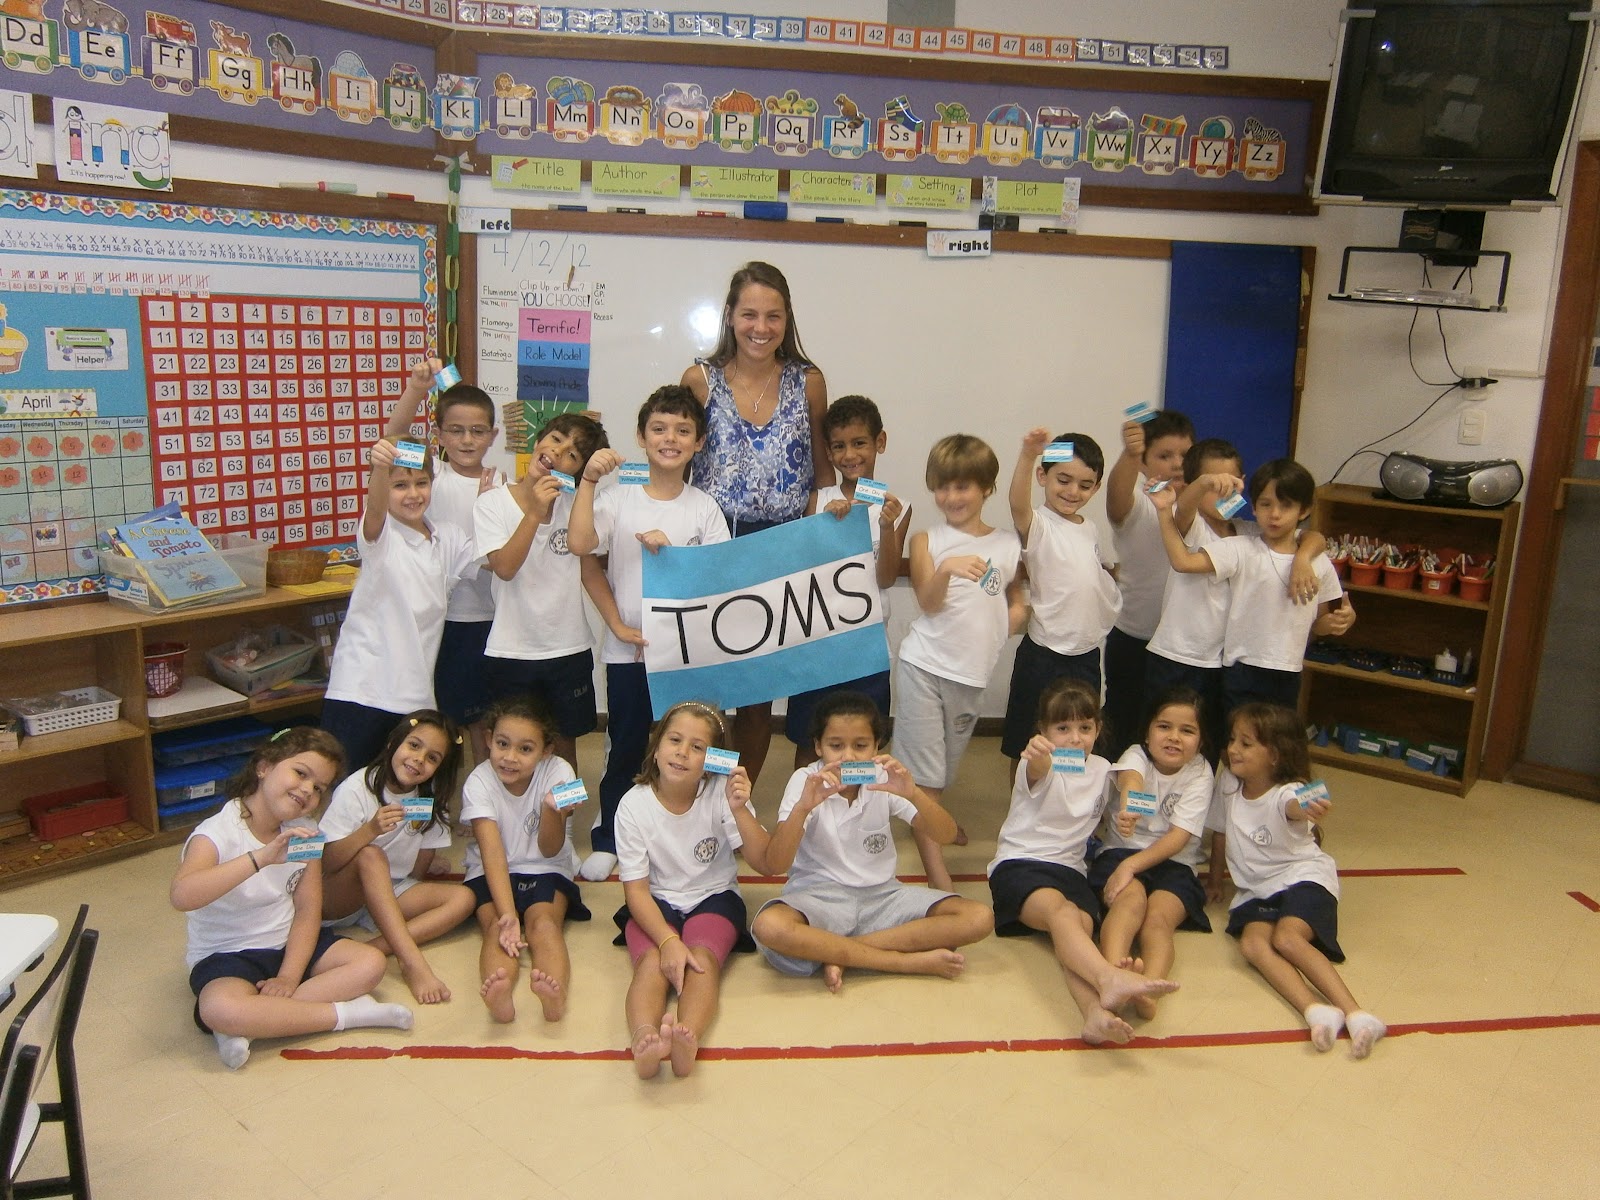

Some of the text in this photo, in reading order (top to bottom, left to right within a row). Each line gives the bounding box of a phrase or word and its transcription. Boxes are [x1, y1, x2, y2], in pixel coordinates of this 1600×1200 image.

[433, 1, 506, 20] 26 28
[813, 24, 1069, 54] 40 41 42 43 44 45 46 47 48 49
[6, 18, 44, 46] Dd
[86, 31, 116, 58] Ee
[159, 44, 186, 69] Ff
[221, 57, 252, 90] Gg
[345, 79, 361, 101] Ii
[394, 87, 414, 119] Jj
[446, 100, 470, 119] Kk
[554, 104, 587, 123] Mm
[613, 106, 640, 126] Nn
[667, 111, 694, 130] Oo
[725, 113, 748, 133] Pp
[776, 117, 805, 143] Qq
[833, 121, 859, 138] Rr
[889, 125, 912, 142] Ss
[942, 125, 963, 144] Tt
[994, 128, 1018, 147] Uu
[1046, 131, 1068, 149] Vv
[1094, 133, 1127, 152] Ww
[1148, 137, 1172, 155] Xx
[1201, 141, 1222, 165] Yy
[1251, 143, 1273, 162] Zz
[85, 171, 114, 181] happening
[532, 161, 564, 176] Title
[602, 163, 648, 180] Author
[719, 168, 775, 183] Illustrator
[802, 172, 852, 187] Characters
[918, 176, 956, 196] Setting
[1015, 182, 1039, 197] Plot
[481, 219, 510, 230] left
[493, 231, 591, 274] 4/12/12
[949, 240, 989, 253] right
[482, 285, 518, 297] Fluminense
[519, 279, 537, 292] Clip
[540, 281, 550, 292] Up
[520, 291, 543, 307] YOU
[546, 293, 591, 308] CHOOSE!
[159, 305, 421, 323] 1 2 3 4 5 6 7 8 9 10
[526, 317, 581, 335] Terrific!
[157, 331, 422, 345] 11 12 13 14 15 16 17 18 19 20
[76, 355, 105, 364] Helper
[525, 346, 582, 361] Role Model
[482, 382, 510, 393] Vasco
[522, 374, 581, 391] Showing Pride
[21, 395, 52, 412] April
[22, 417, 145, 429] Wednesday Thursday Friday Saturday
[166, 452, 352, 477] 61 62 63 64 65 66 67
[72, 470, 82, 479] 12
[202, 498, 355, 525] 82 83 84 85 86 87
[128, 525, 191, 540] A Cheese
[147, 535, 173, 548] and
[152, 539, 202, 559] Tomato
[651, 562, 873, 665] TOMS
